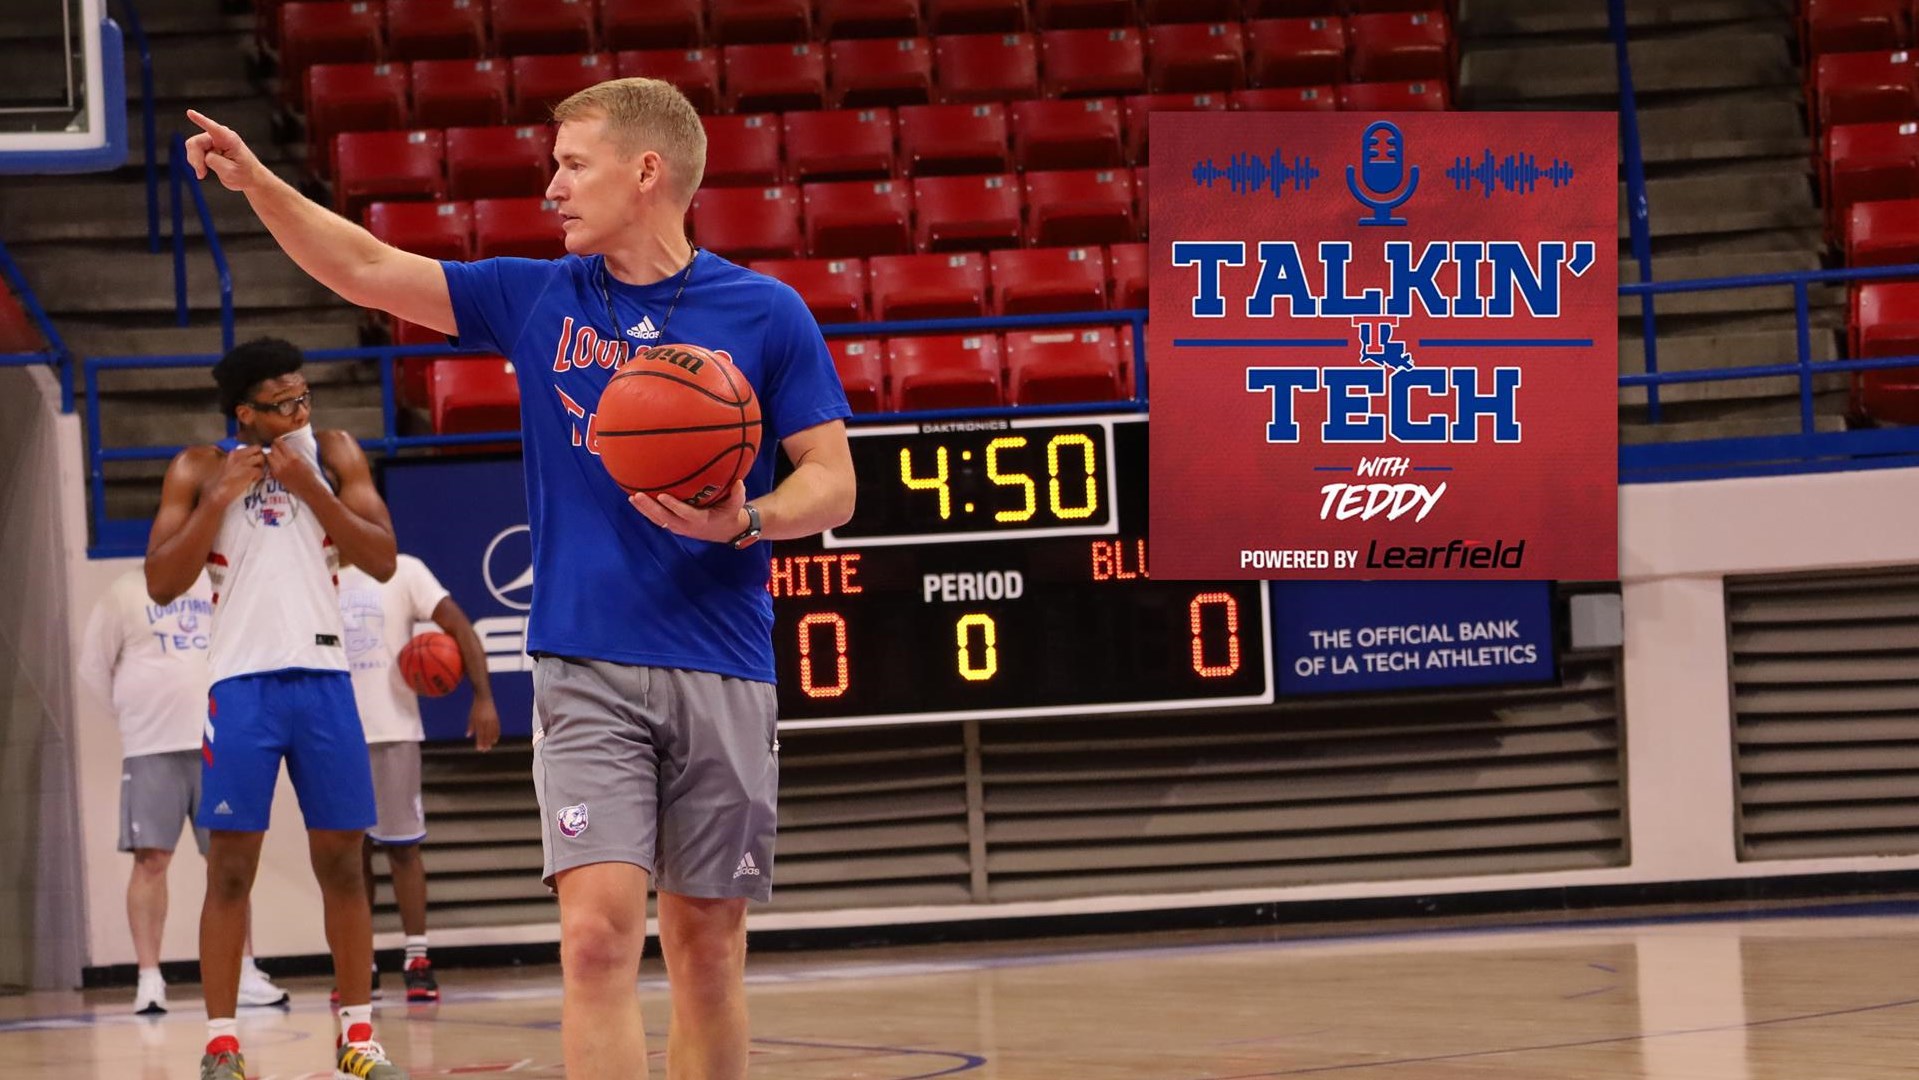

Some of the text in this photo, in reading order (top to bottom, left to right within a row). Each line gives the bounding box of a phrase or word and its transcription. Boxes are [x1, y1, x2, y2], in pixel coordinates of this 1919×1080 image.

[922, 420, 1008, 433] DAKTRONICS
[900, 434, 1097, 522] 4:50
[767, 554, 862, 597] HITE
[923, 570, 1023, 602] PERIOD
[153, 631, 210, 653] TEC
[957, 613, 996, 680] 0
[1190, 591, 1240, 677] 0
[1309, 620, 1519, 649] THE OFFICIAL BANK
[799, 612, 848, 697] 0
[1295, 645, 1537, 676] OF LA TECH ATHLETICS
